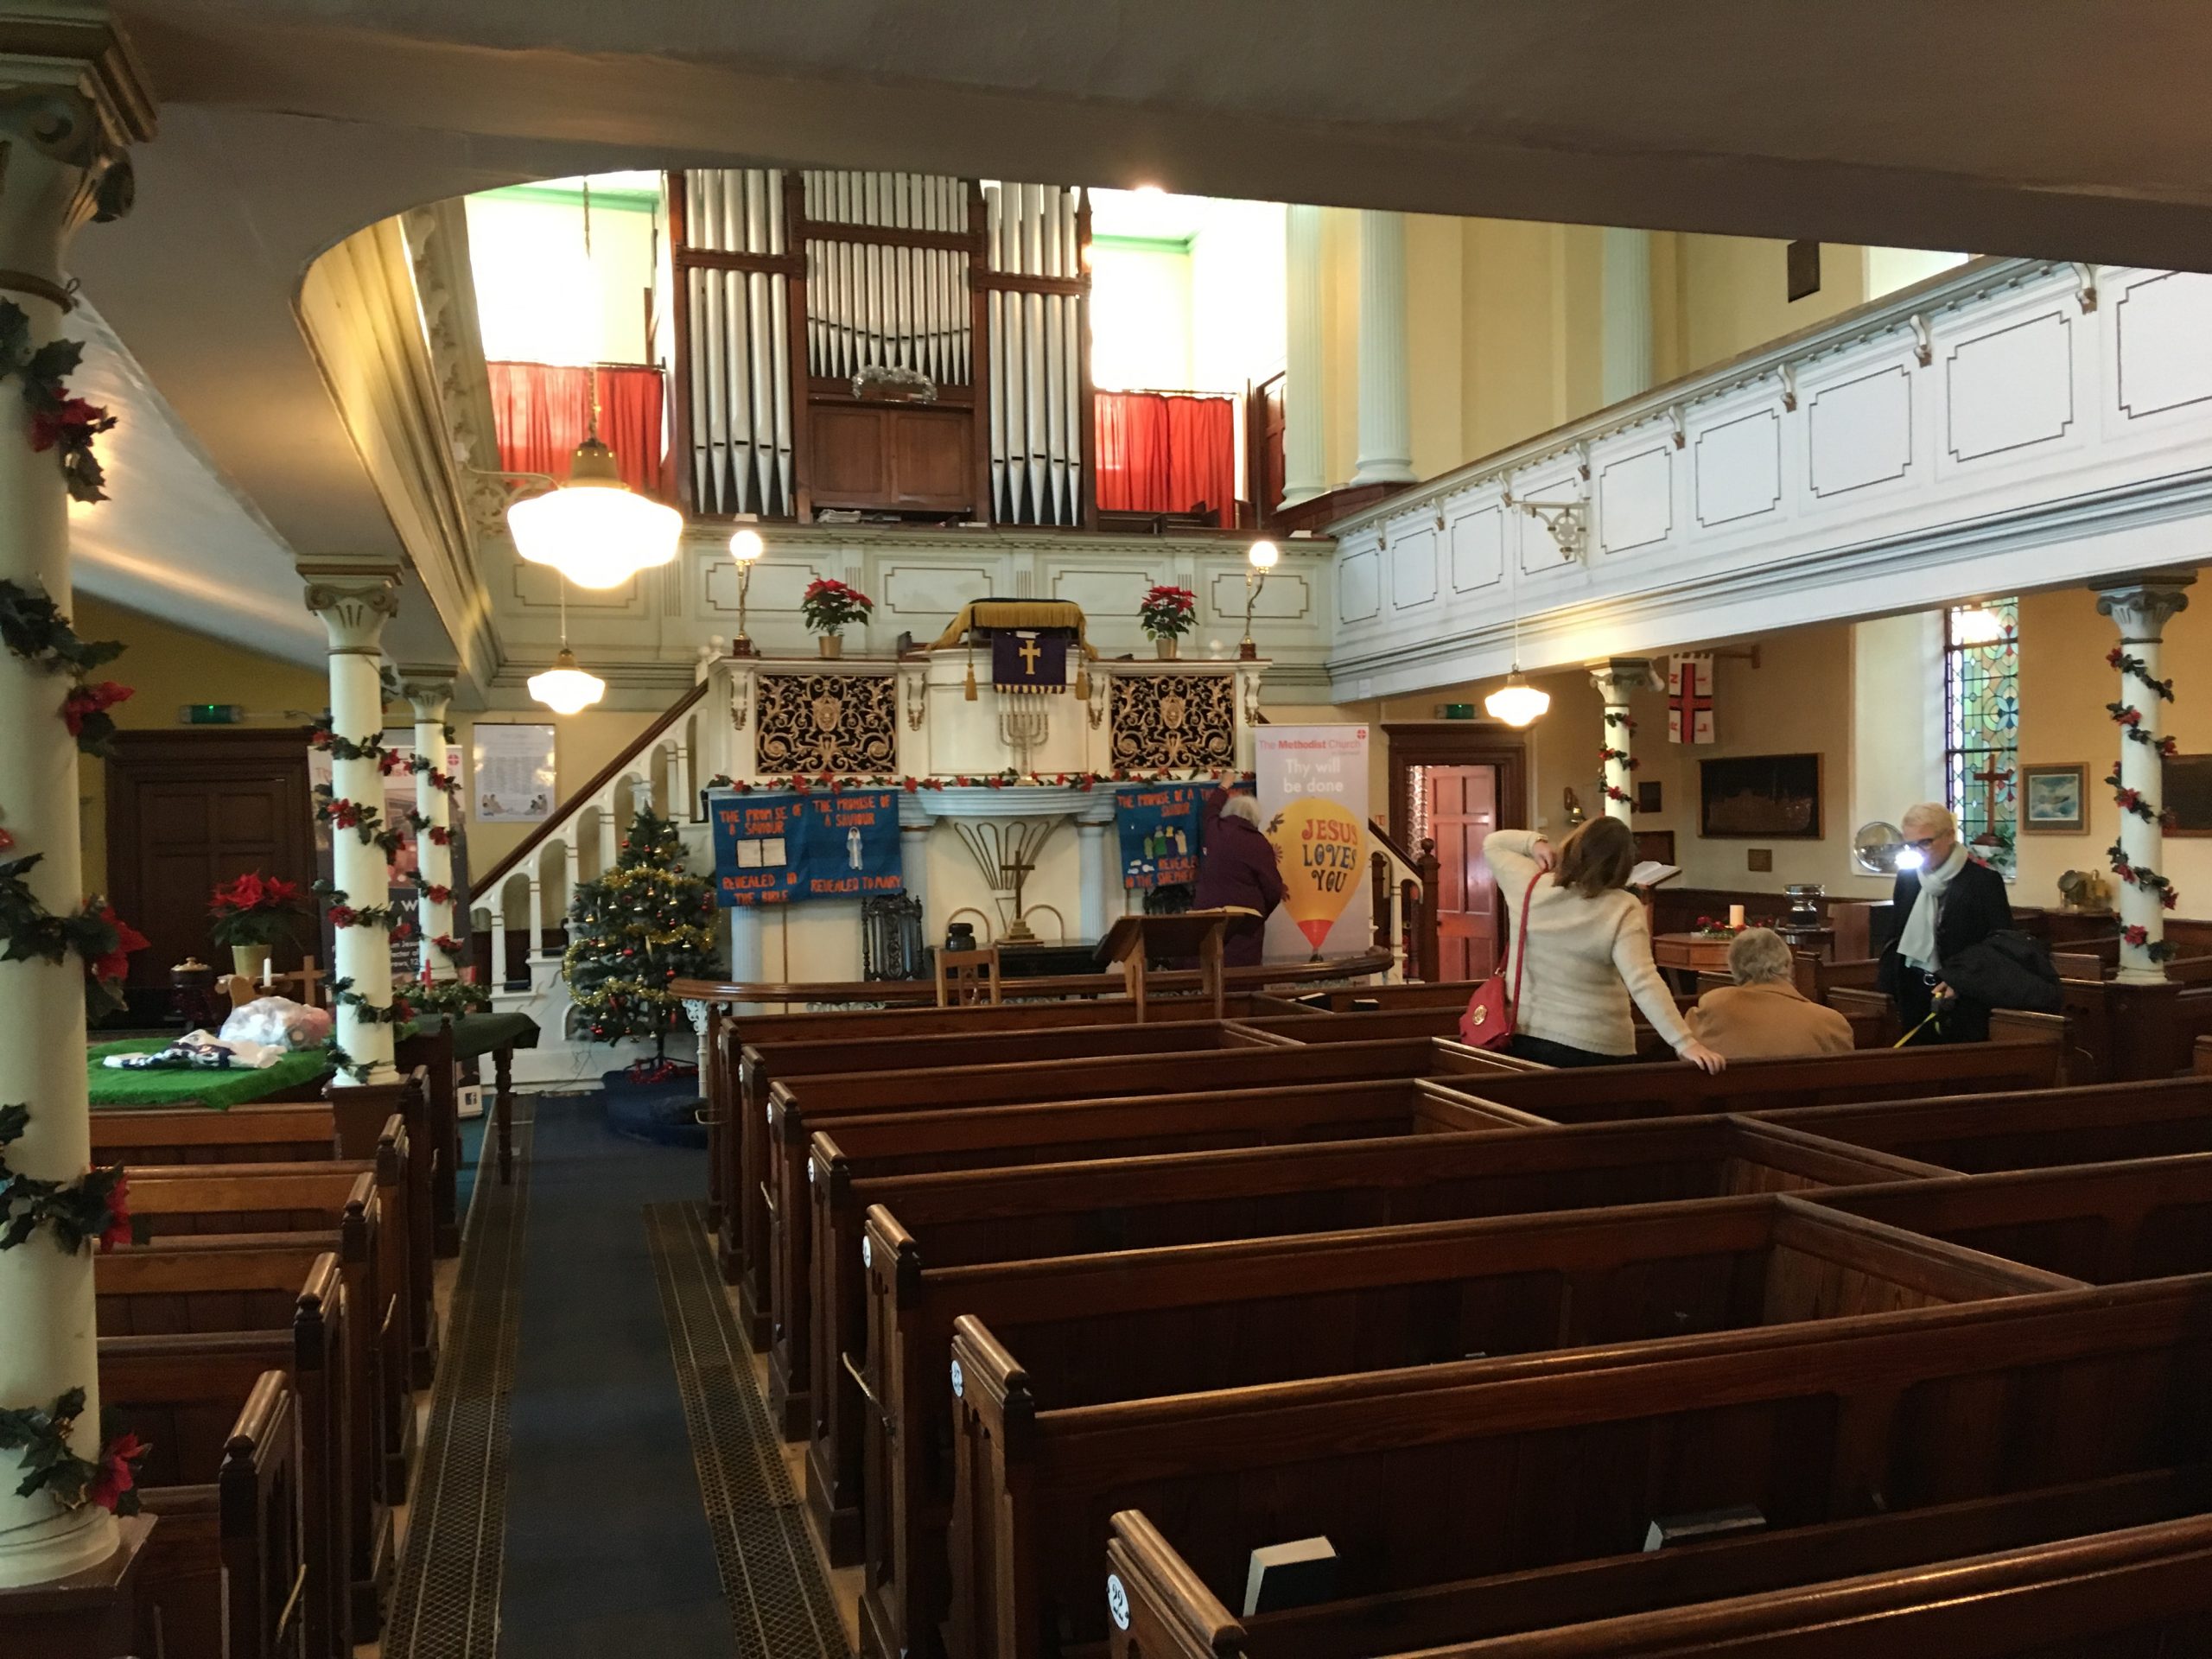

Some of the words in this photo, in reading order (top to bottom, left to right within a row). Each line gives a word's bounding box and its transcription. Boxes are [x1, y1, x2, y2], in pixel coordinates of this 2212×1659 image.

[1278, 740, 1326, 750] Methodist
[1285, 759, 1311, 779] Thy
[1316, 757, 1341, 774] will
[1283, 778, 1302, 793] be
[1306, 777, 1344, 793] done
[813, 799, 832, 812] THE
[837, 796, 875, 810] PROMISE
[720, 810, 740, 823] THE
[836, 813, 874, 826] SAVIOUR
[1302, 818, 1358, 845] JESUS
[1302, 843, 1357, 870] LOVES
[723, 874, 774, 890] REVEALED
[811, 878, 857, 892] REVEALED
[861, 876, 874, 890] TO
[875, 876, 901, 889] MARY
[1312, 869, 1348, 893] YOU
[734, 893, 755, 905] THE
[1112, 1584, 1123, 1622] 22
